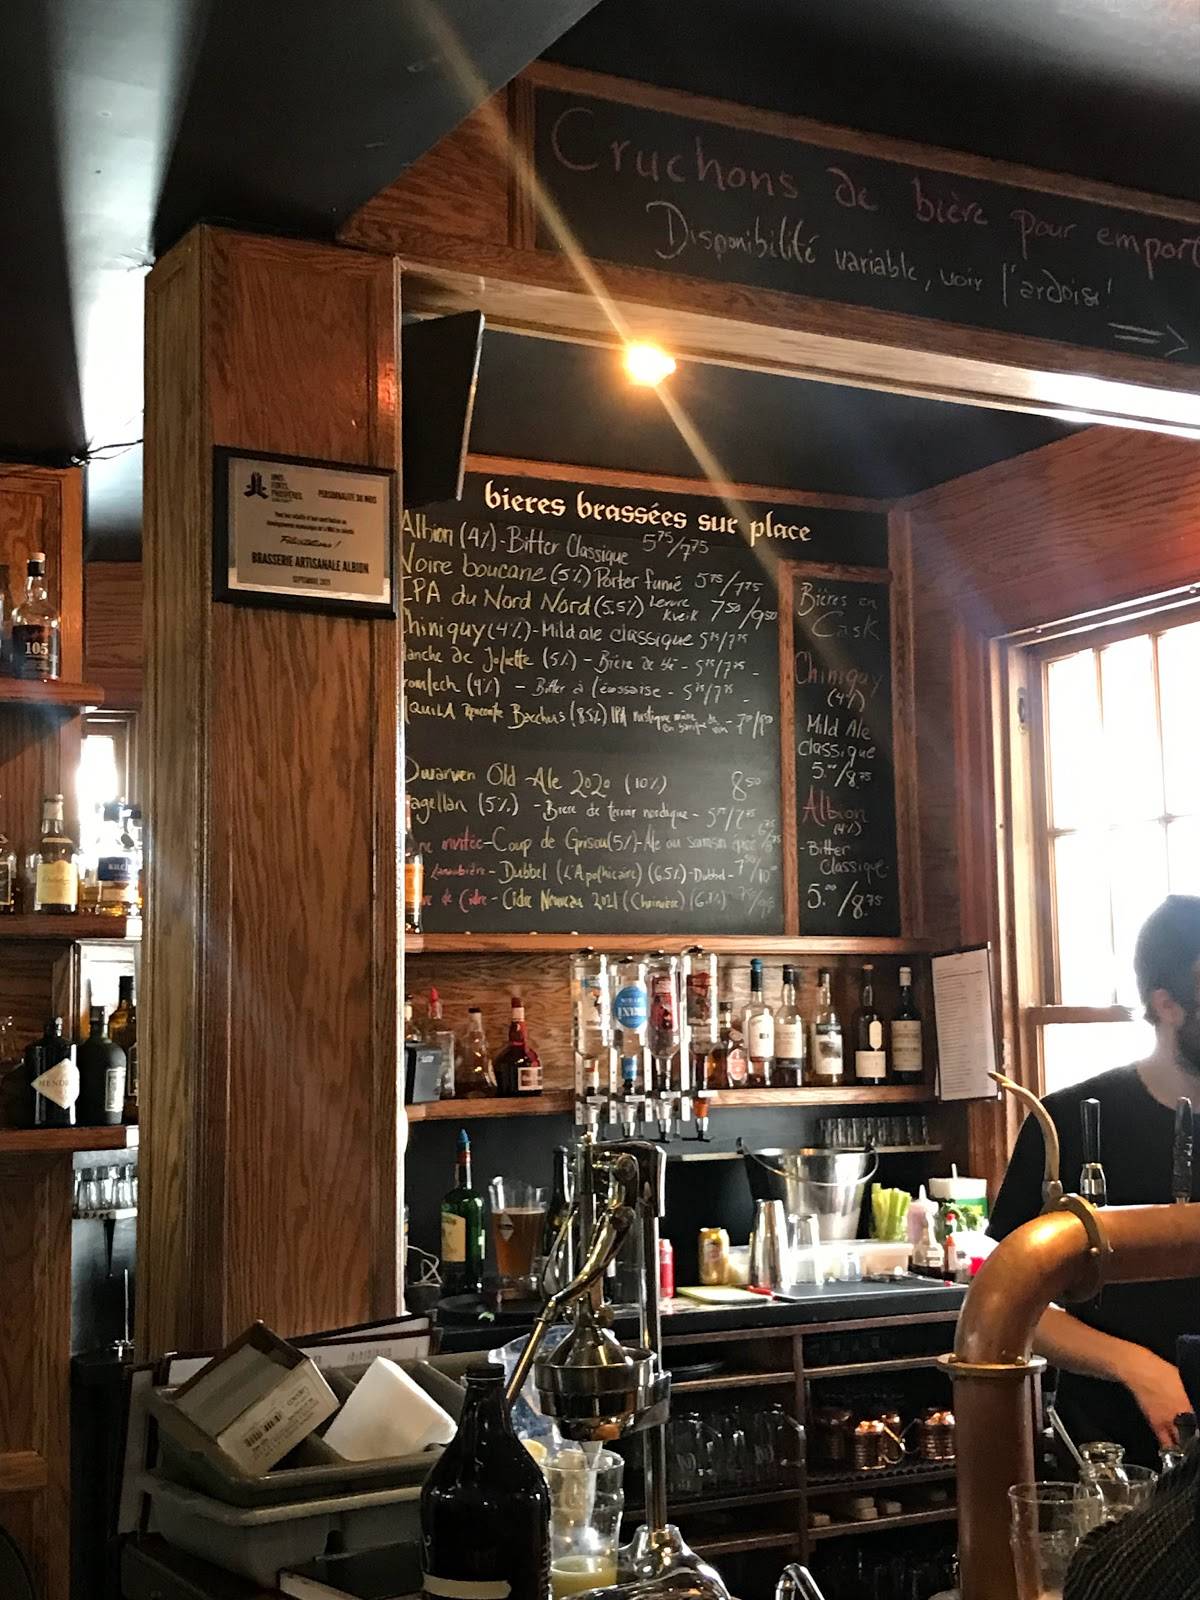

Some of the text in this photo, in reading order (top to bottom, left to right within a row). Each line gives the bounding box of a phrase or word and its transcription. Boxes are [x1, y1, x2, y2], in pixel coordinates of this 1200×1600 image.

[552, 107, 798, 199] Cruchons
[825, 167, 877, 211] de
[1010, 208, 1078, 259] pour
[576, 490, 688, 529] brassées
[698, 512, 738, 534] sur
[750, 511, 812, 547] place
[251, 552, 293, 567] BRASSERIE
[295, 556, 341, 572] ARTISANALE
[566, 533, 629, 566] Classique
[593, 566, 639, 589] Porter
[402, 575, 441, 604] PA
[451, 584, 478, 607] du
[483, 585, 531, 610] Nord
[540, 588, 591, 616] Nord
[402, 607, 487, 647] hiniquy
[24, 642, 49, 656] 105
[450, 646, 474, 664] de
[403, 668, 461, 696] romlech
[807, 713, 871, 740] Mild Ale
[486, 762, 517, 787] Old
[570, 769, 611, 798] 2020
[408, 791, 468, 824] agellan
[586, 801, 600, 816] de
[540, 825, 556, 849] de
